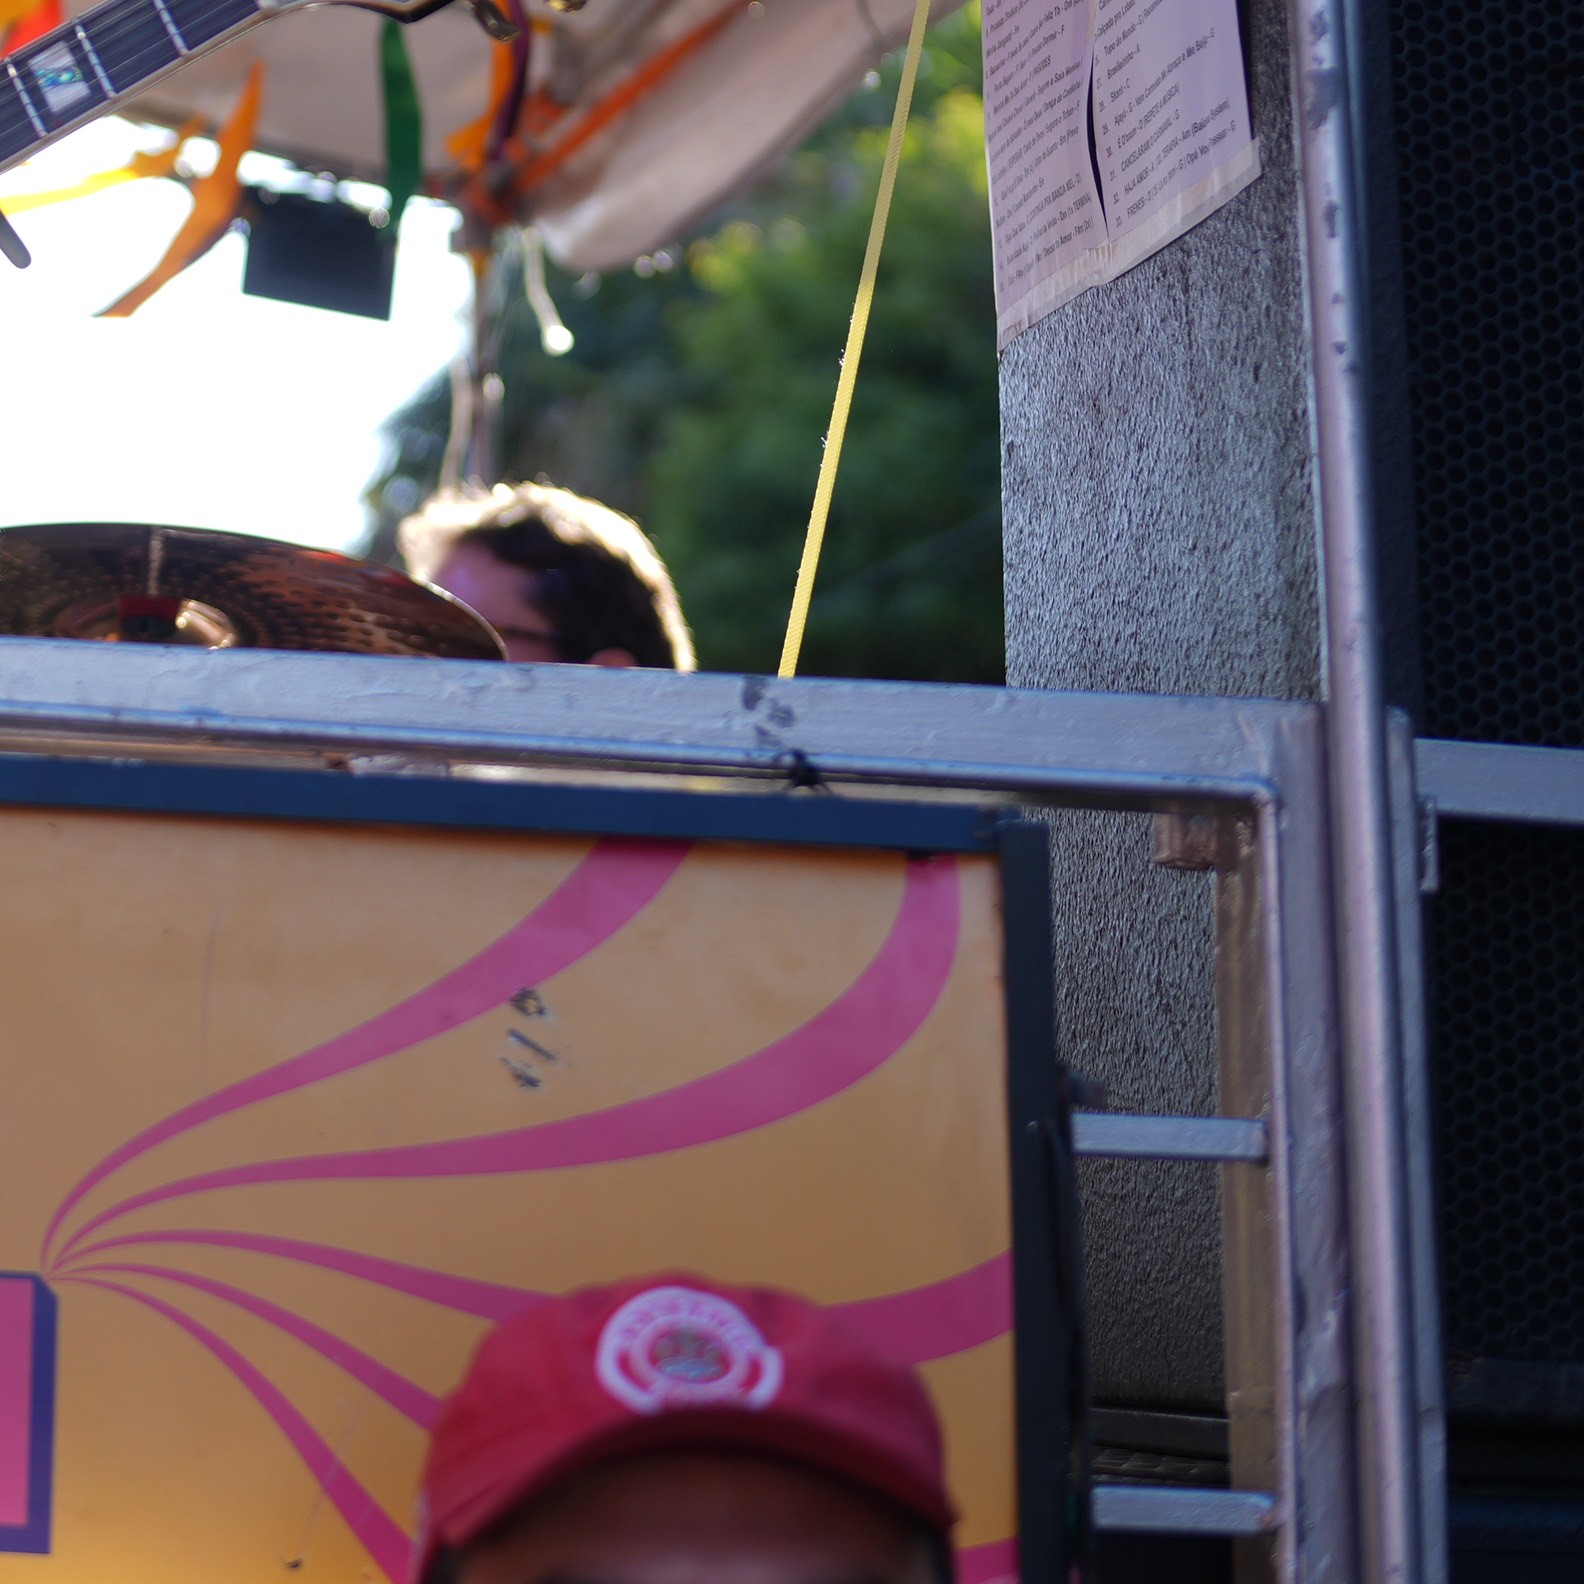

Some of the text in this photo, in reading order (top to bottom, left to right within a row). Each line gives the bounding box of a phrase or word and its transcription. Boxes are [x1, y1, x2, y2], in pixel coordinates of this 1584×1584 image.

[1122, 24, 1135, 40] Mundo
[1121, 140, 1149, 171] CANCELARAM
[1136, 167, 1148, 183] AMOR
